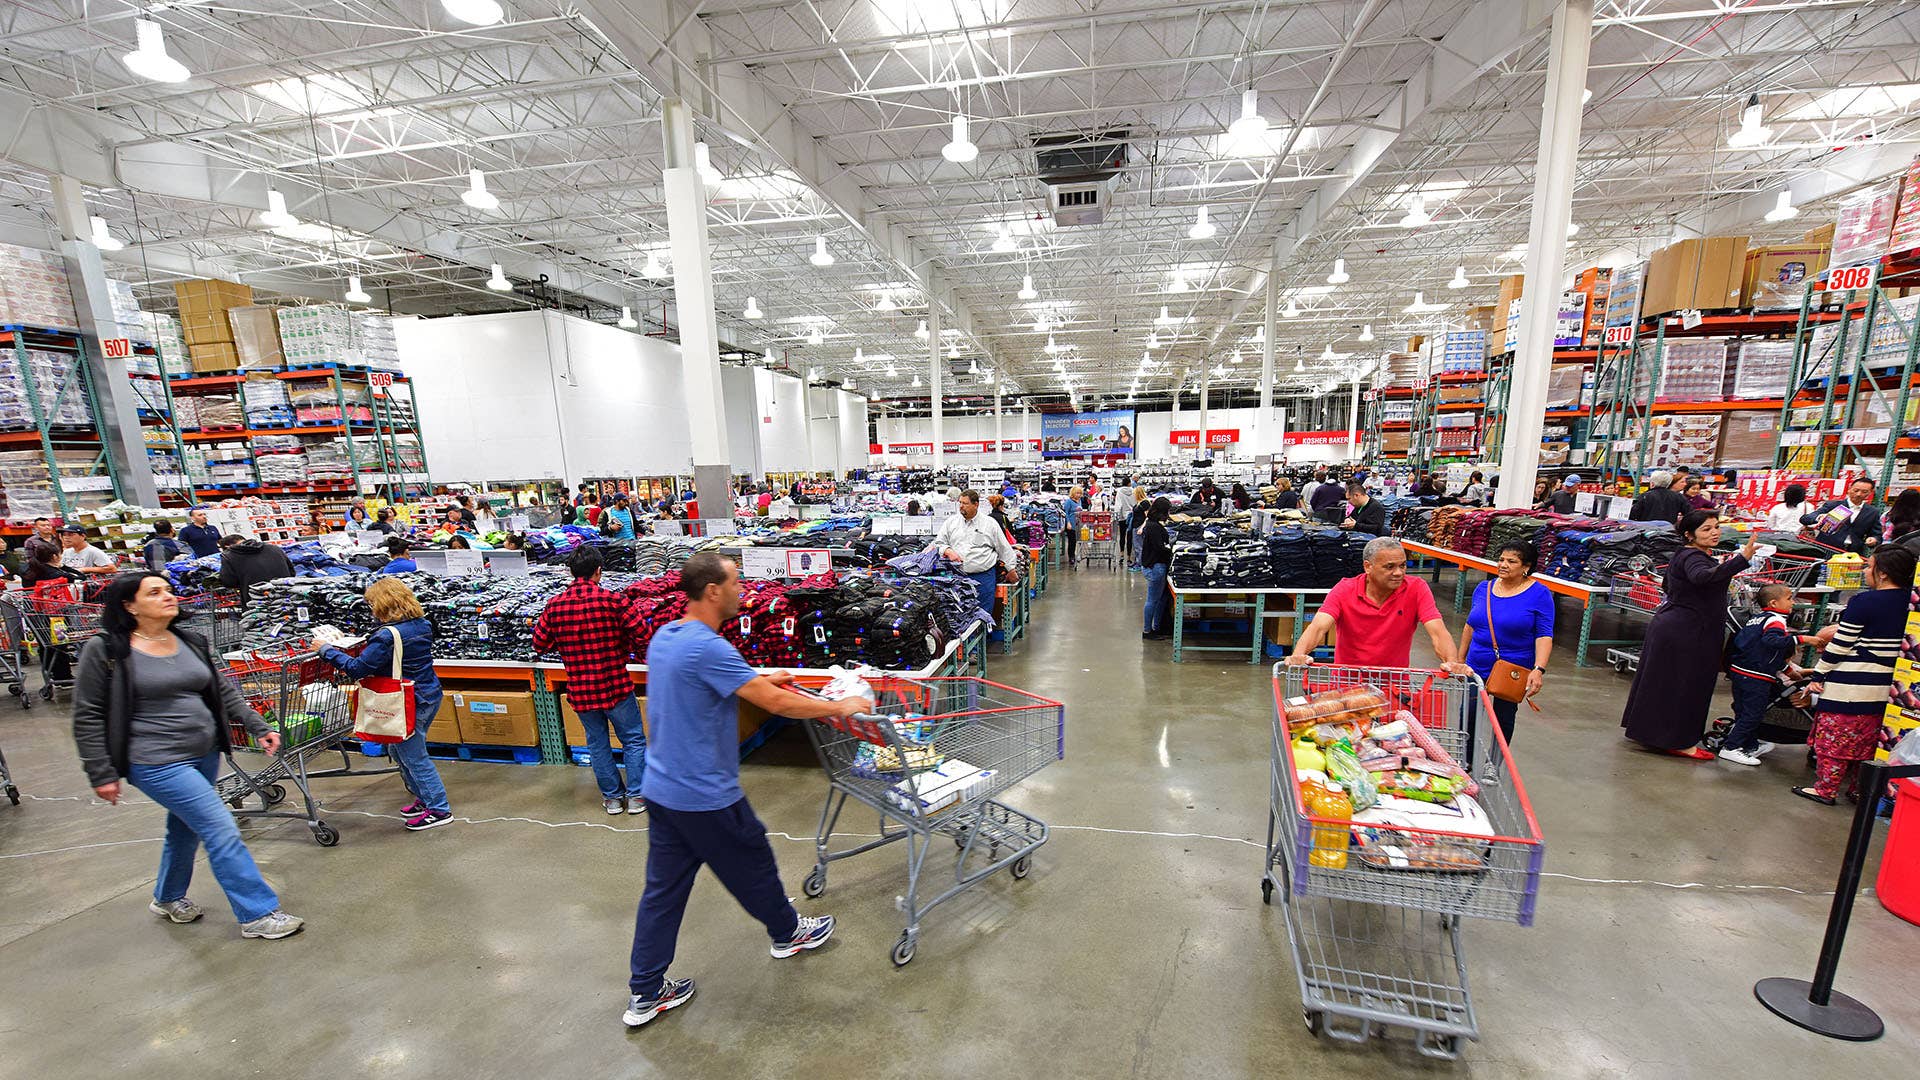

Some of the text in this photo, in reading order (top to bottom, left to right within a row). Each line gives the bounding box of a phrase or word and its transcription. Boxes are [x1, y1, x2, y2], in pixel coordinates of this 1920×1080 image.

[1830, 267, 1871, 290] 308
[1607, 327, 1632, 343] 310
[104, 338, 129, 357] 507
[371, 373, 392, 388] 509
[1412, 379, 1427, 389] 314
[1177, 435, 1196, 443] MILK
[1211, 434, 1232, 443] EGGS
[1328, 436, 1349, 444] BAKER
[908, 446, 928, 454] MEAT
[466, 566, 483, 575] 9.99
[766, 567, 786, 577] 9.99
